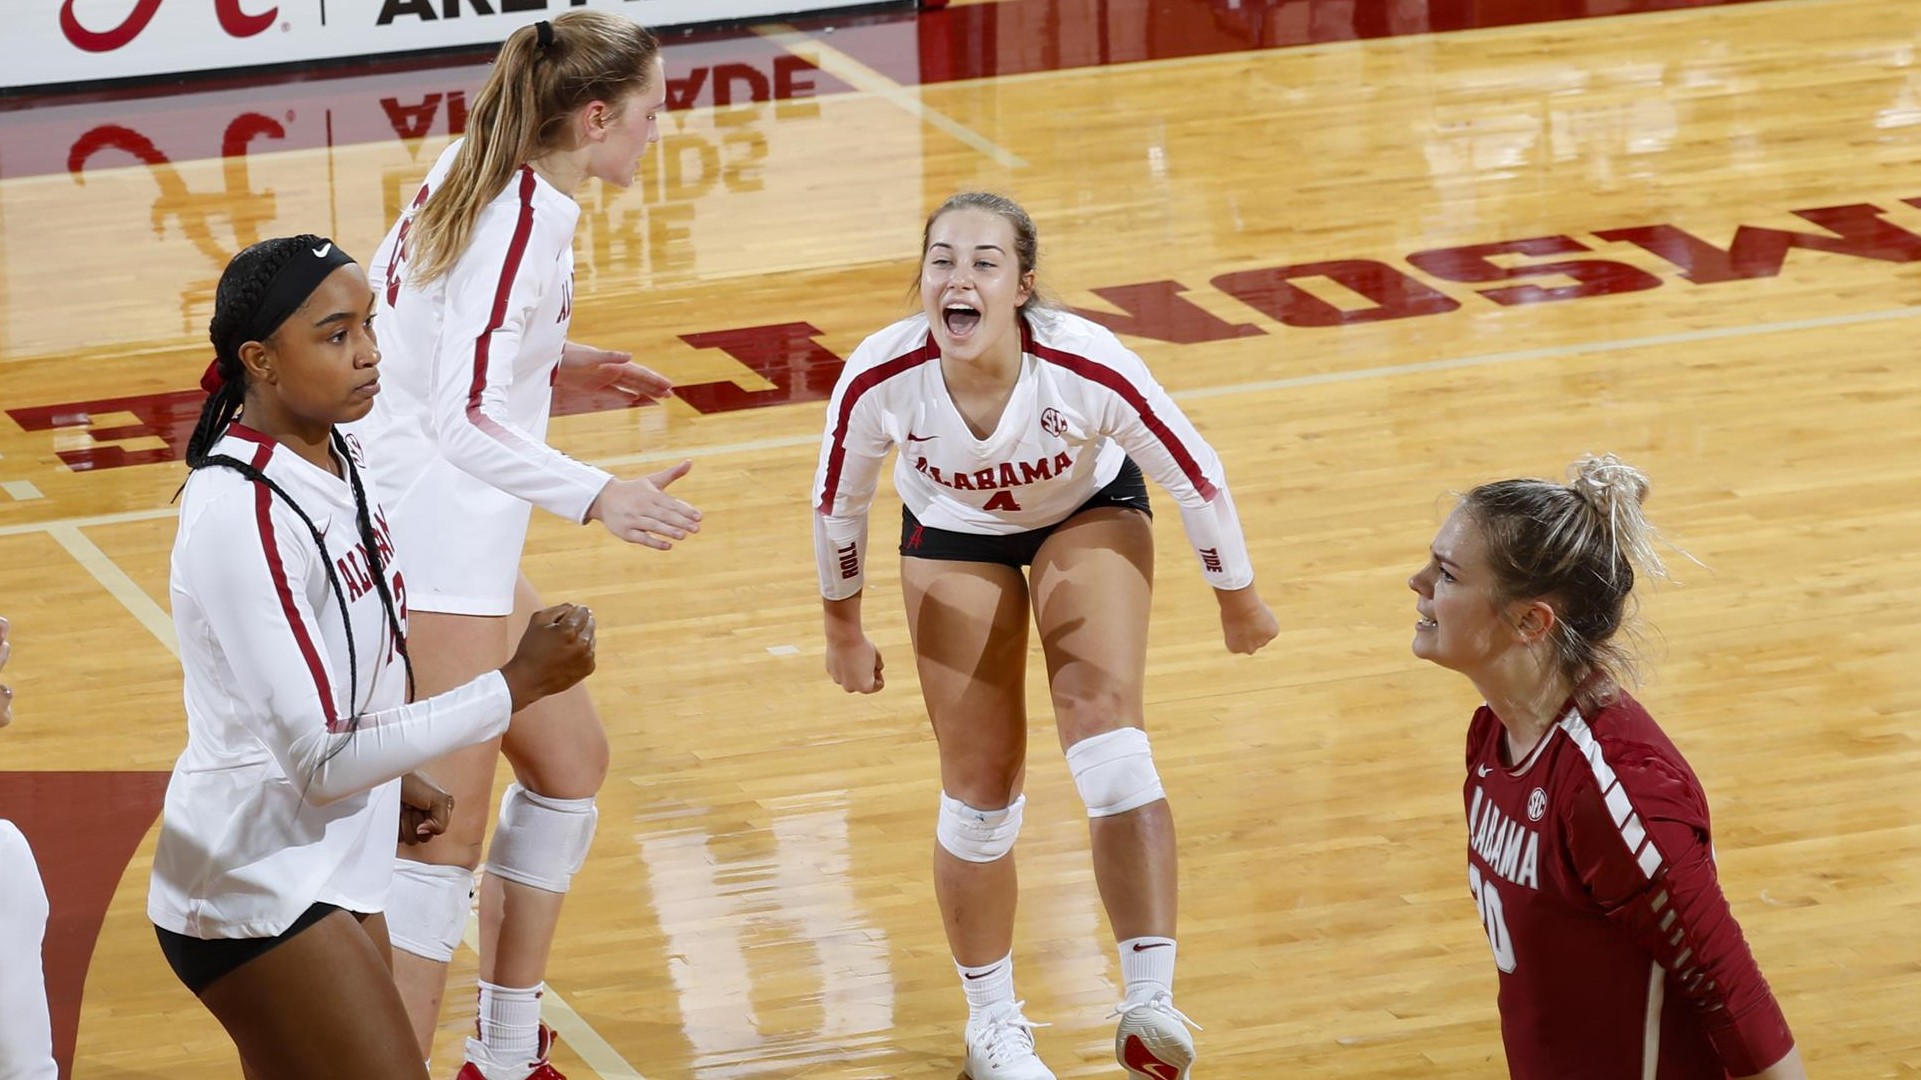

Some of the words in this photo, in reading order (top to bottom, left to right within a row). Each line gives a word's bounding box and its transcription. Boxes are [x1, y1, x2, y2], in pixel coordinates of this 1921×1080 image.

[915, 451, 1073, 490] ALABAMA
[982, 490, 1022, 512] 4
[838, 541, 859, 579] ROLL
[1199, 547, 1223, 573] TIDE
